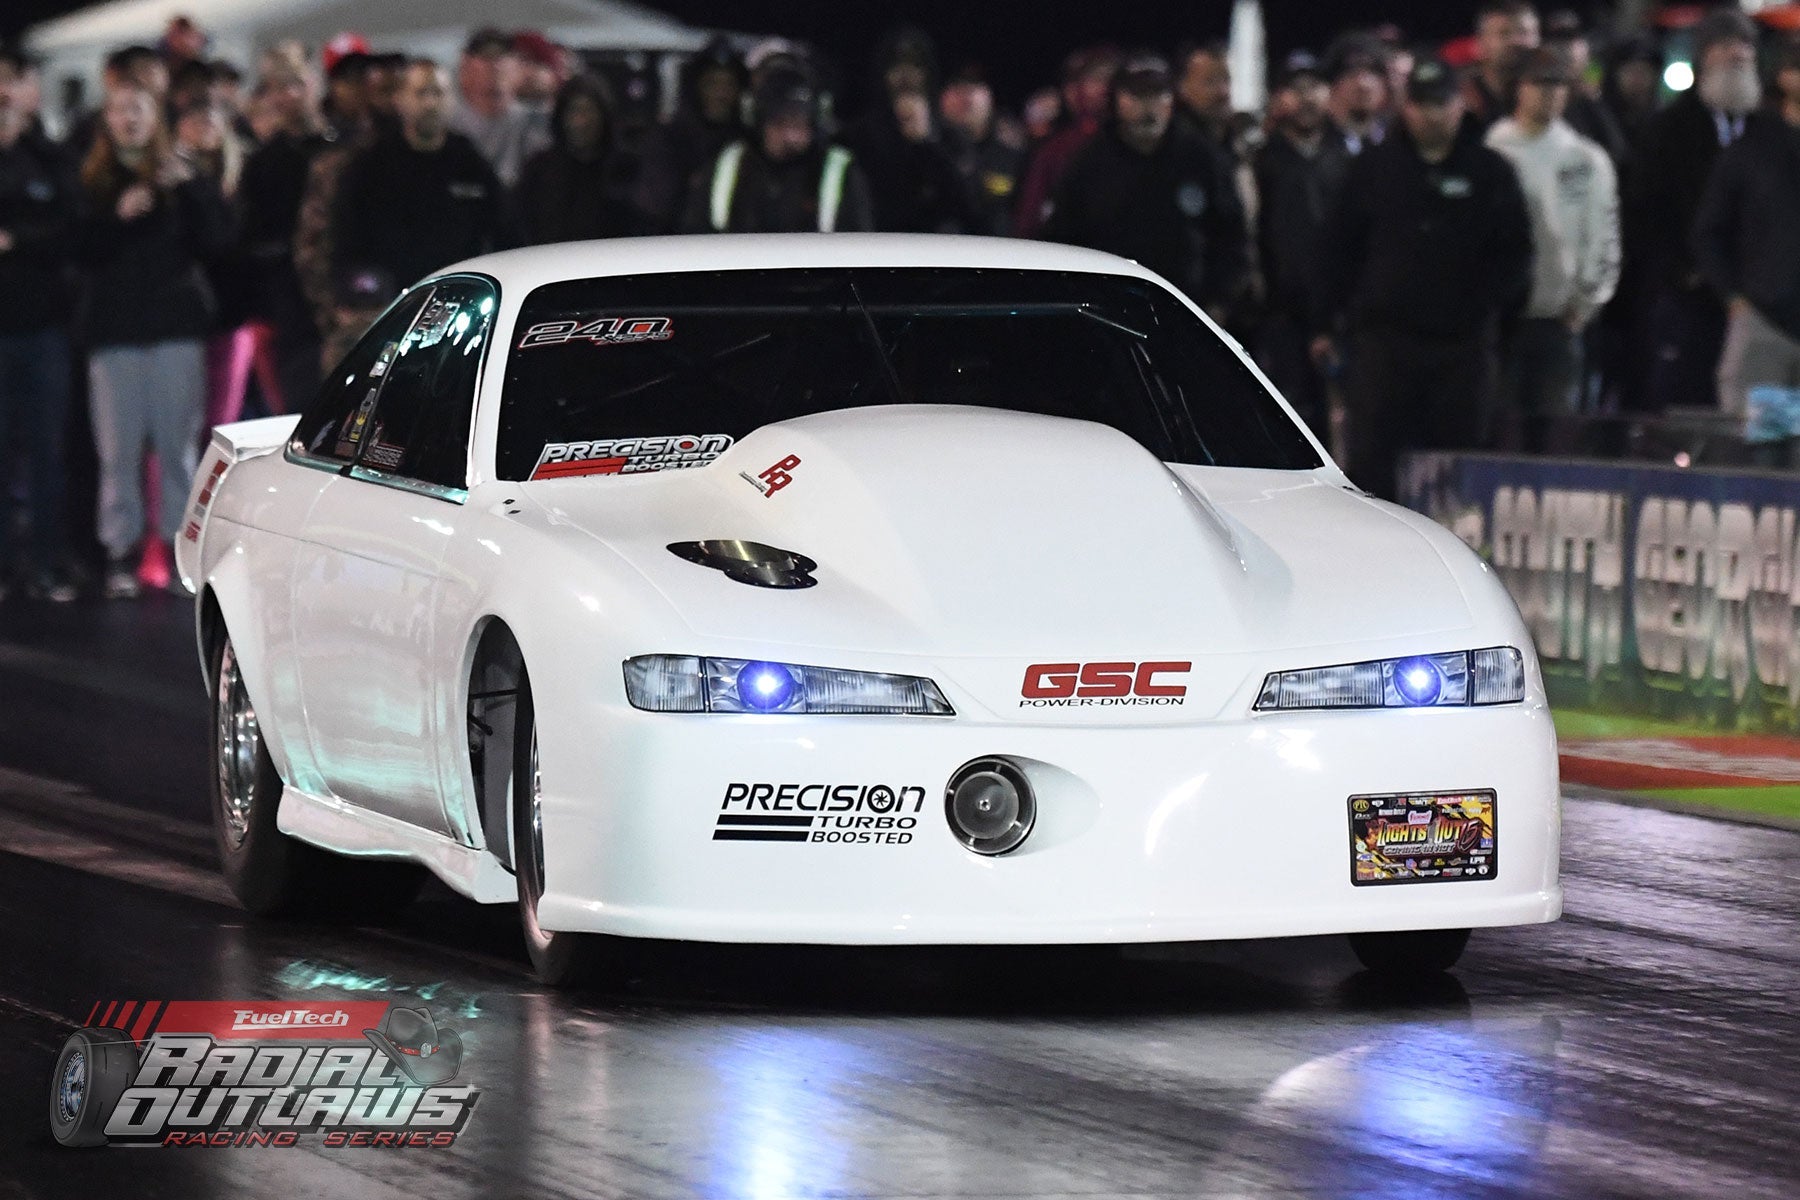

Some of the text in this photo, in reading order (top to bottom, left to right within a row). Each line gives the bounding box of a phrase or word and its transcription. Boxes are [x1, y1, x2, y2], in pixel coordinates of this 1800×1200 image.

[517, 316, 673, 350] 240
[540, 435, 733, 465] PRECISION
[627, 451, 721, 465] TURBO
[1021, 661, 1193, 699] GSC
[1018, 696, 1185, 708] POWER-DIVISION
[720, 782, 927, 814] PRECISION
[816, 815, 918, 830] TURBO
[1376, 818, 1429, 847] LIGHTS
[1433, 818, 1461, 844] OUT
[810, 831, 914, 845] BOOSTED
